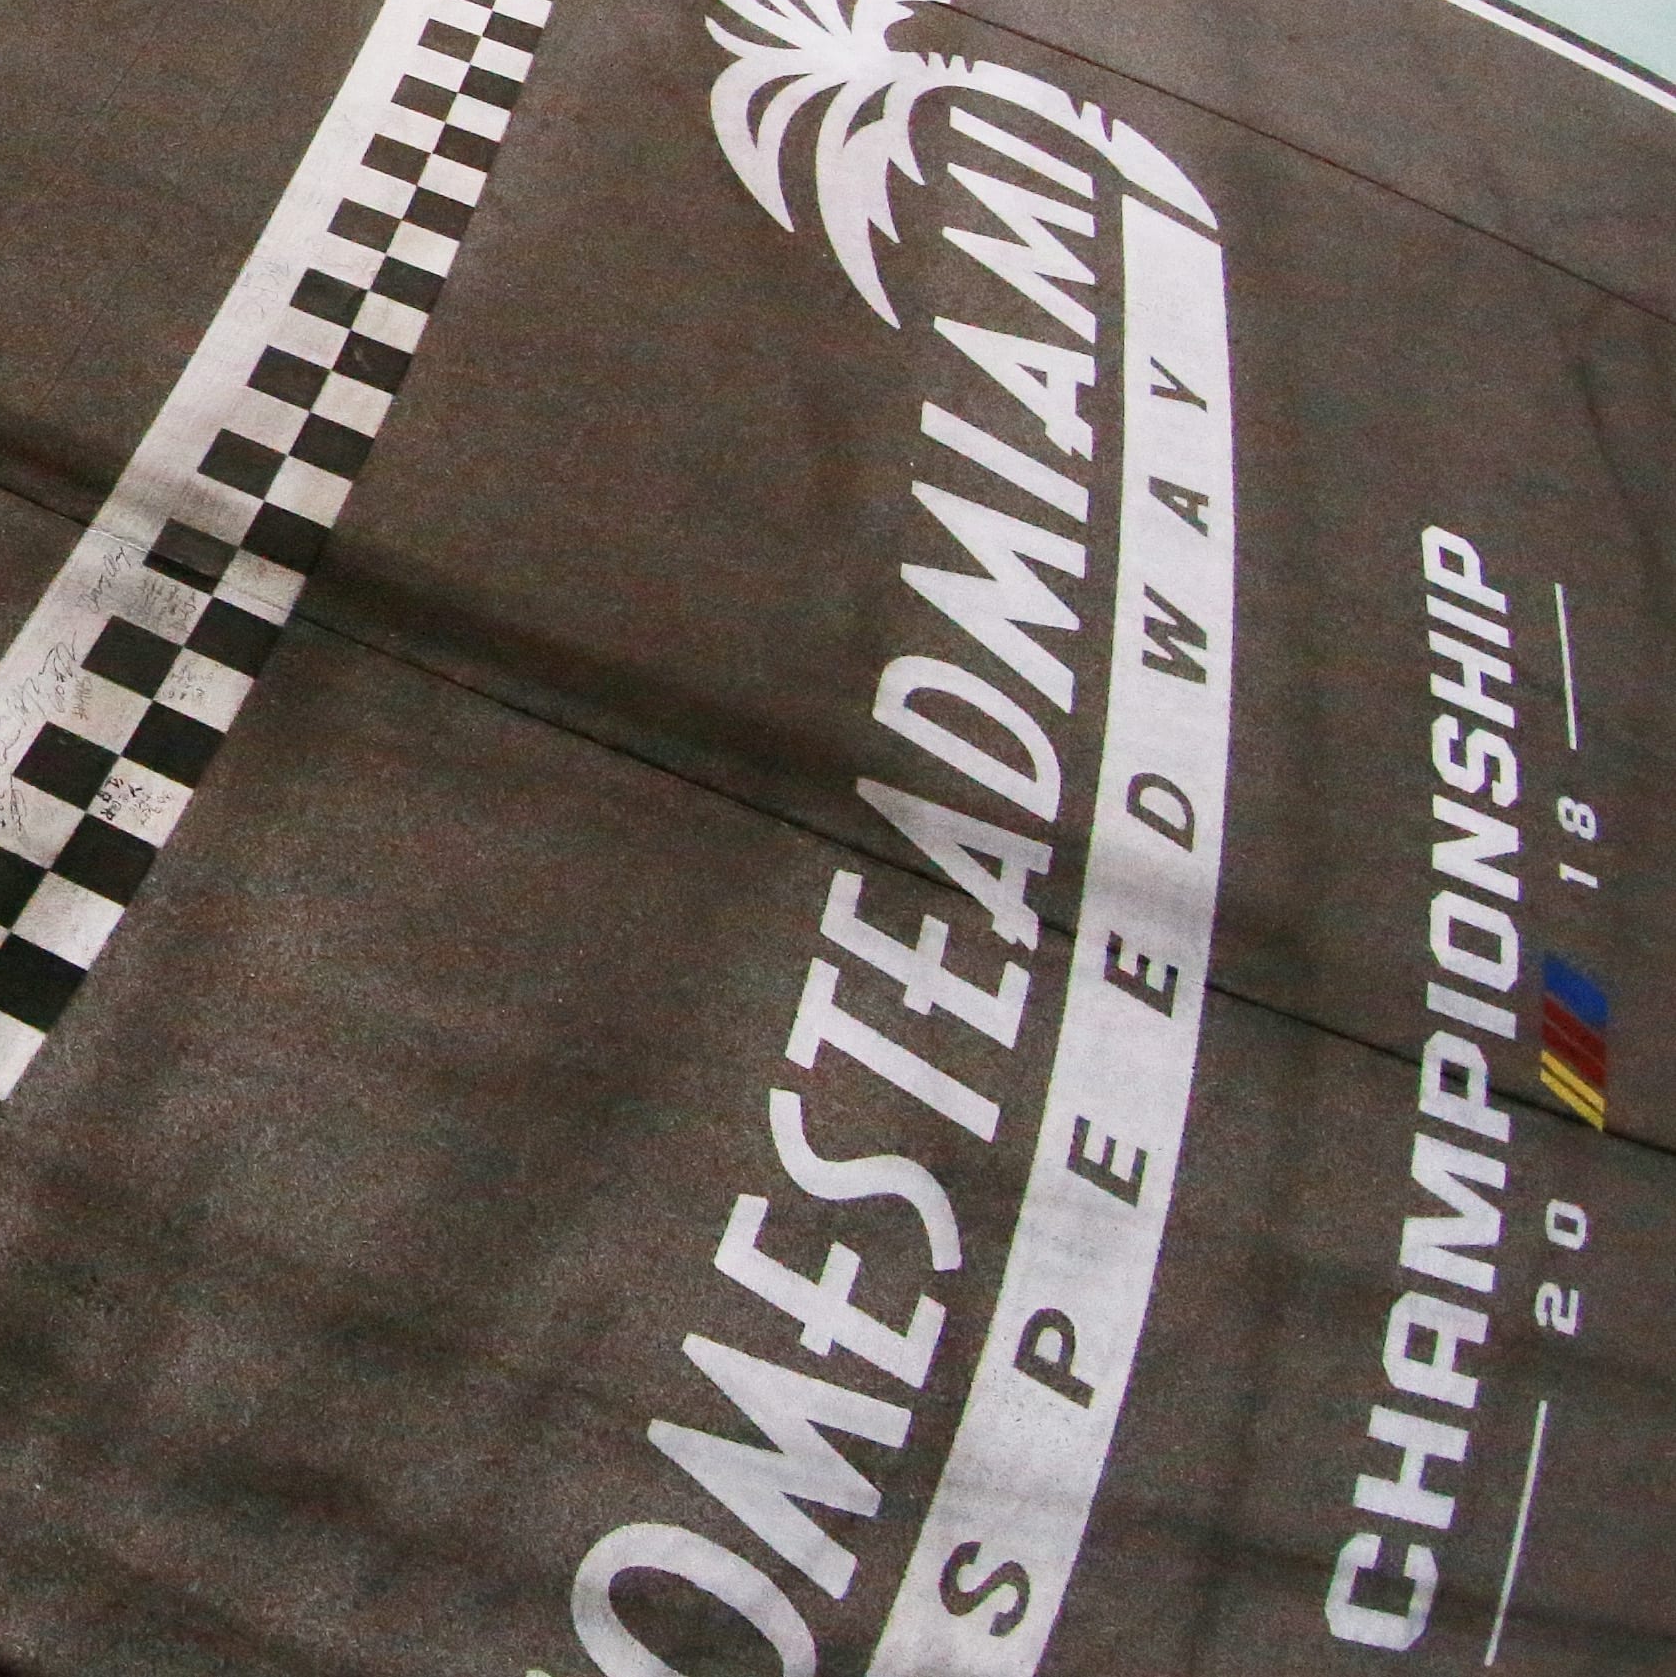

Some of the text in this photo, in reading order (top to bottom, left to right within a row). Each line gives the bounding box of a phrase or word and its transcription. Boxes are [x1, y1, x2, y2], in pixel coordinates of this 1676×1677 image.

[939, 356, 1210, 1638] SPEEDWAY
[1324, 524, 1521, 1652] CHAMPIONSHIP
[1534, 795, 1599, 1337] 20 18
